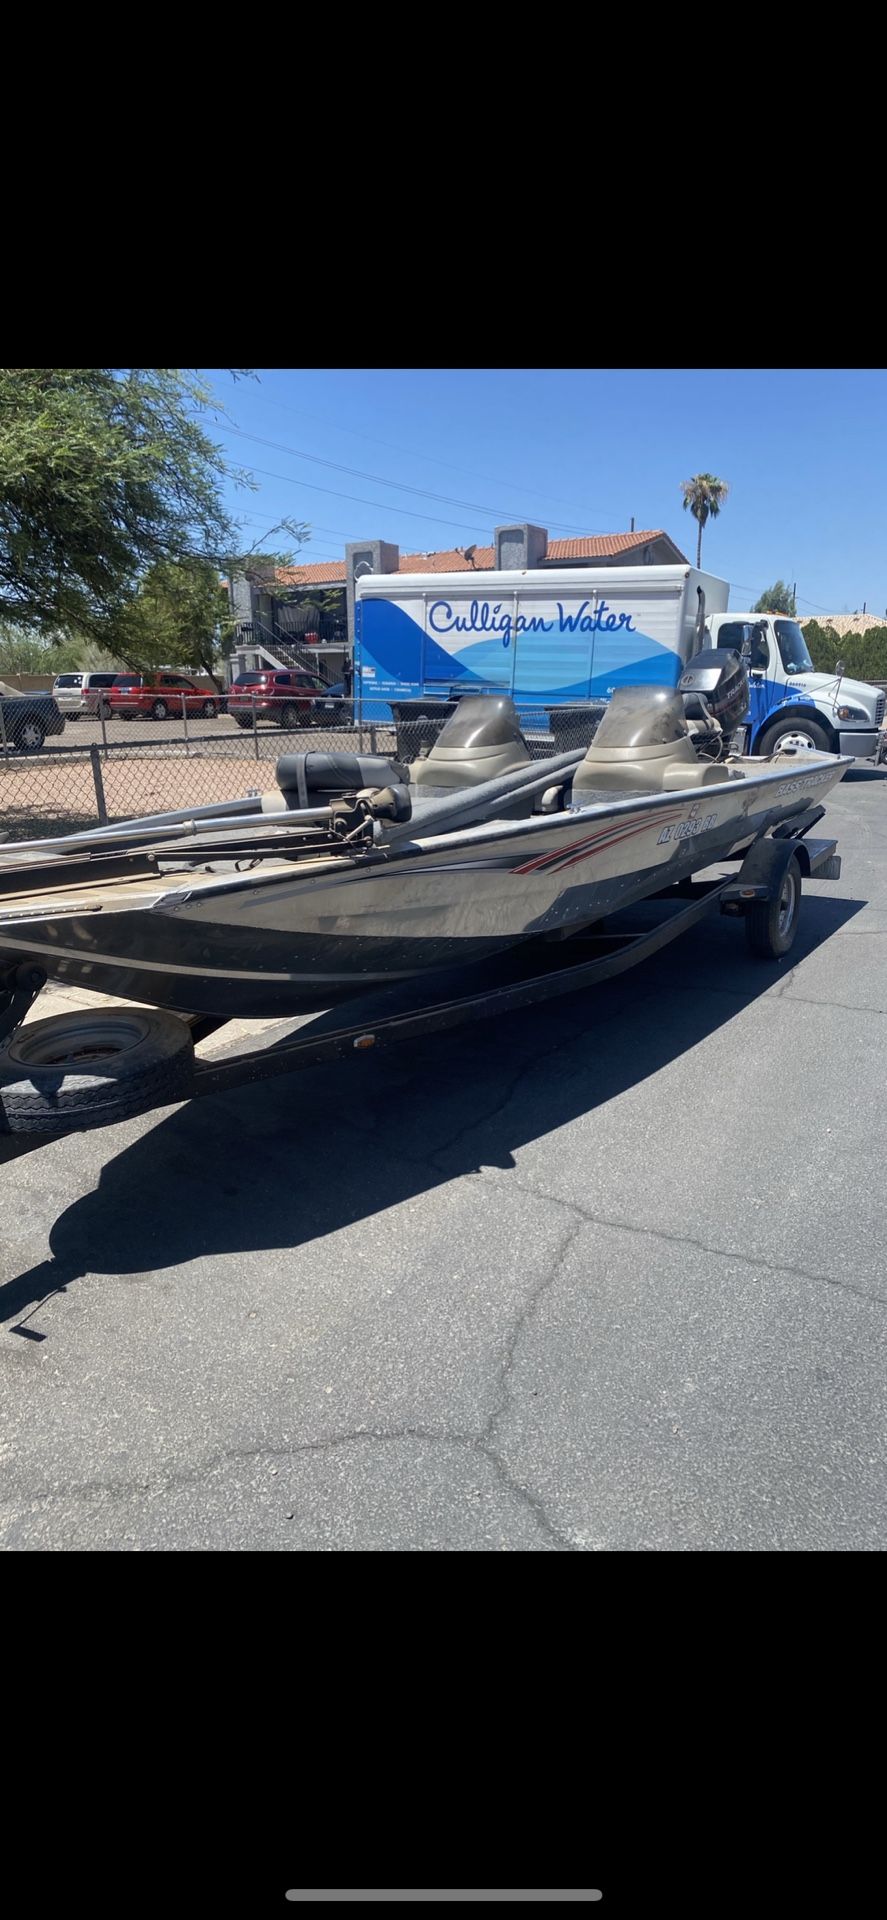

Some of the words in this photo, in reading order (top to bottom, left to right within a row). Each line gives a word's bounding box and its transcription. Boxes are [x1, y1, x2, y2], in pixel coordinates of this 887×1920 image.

[429, 600, 553, 648] Culligan
[556, 601, 636, 632] Water
[657, 825, 675, 845] AZ
